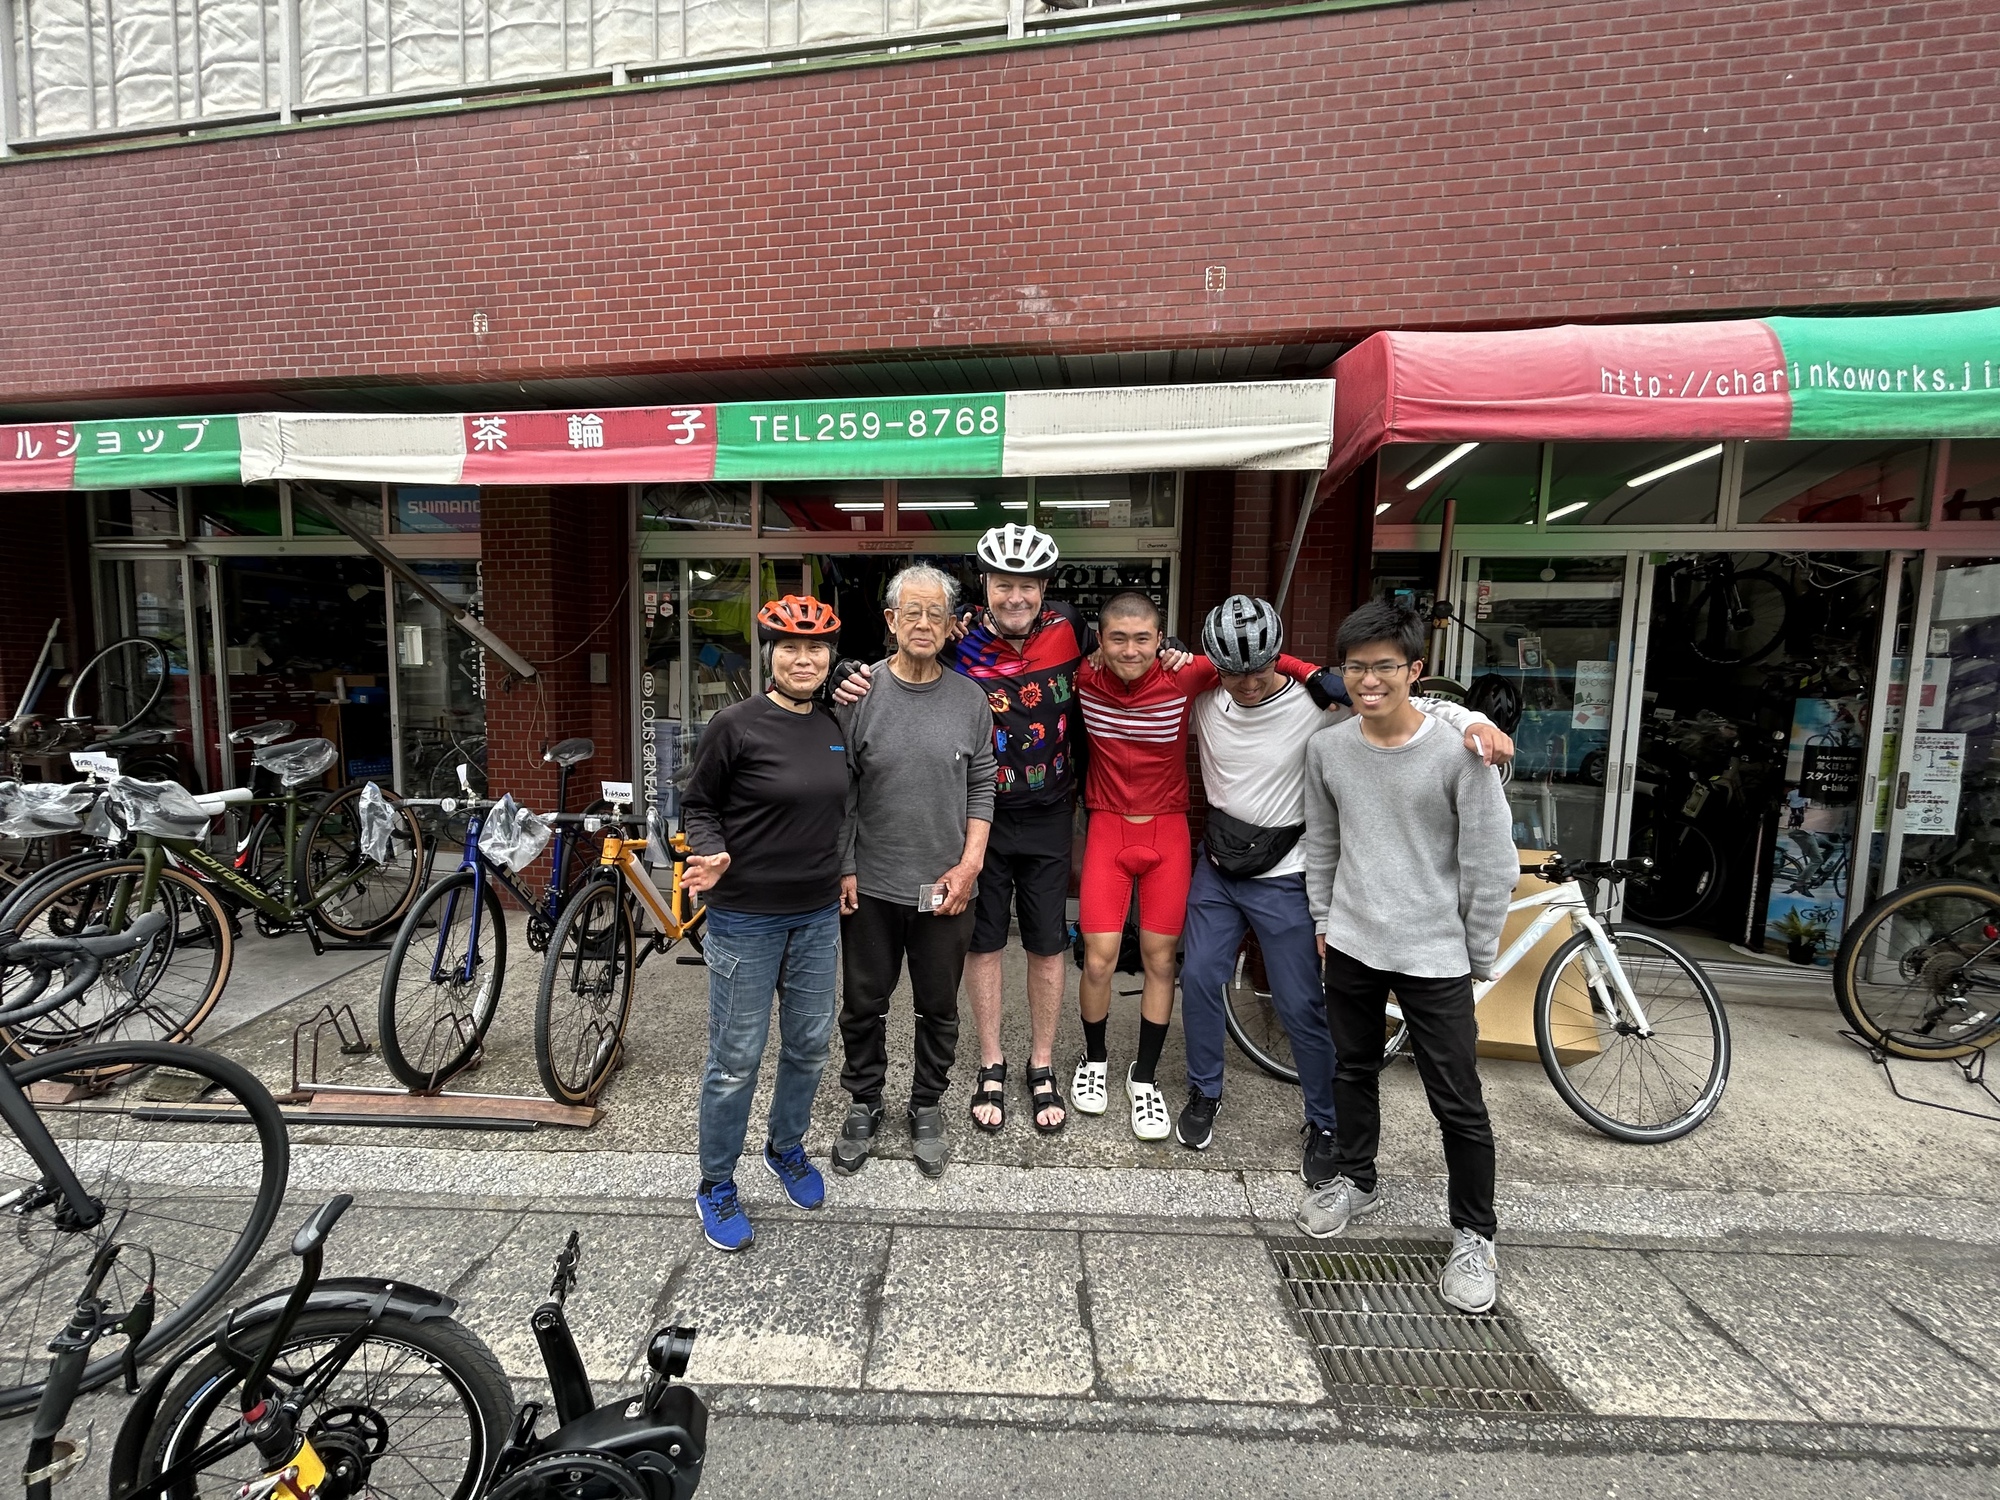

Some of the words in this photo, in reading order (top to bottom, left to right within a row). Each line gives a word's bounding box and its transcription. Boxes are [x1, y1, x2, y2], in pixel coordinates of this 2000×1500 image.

[1600, 359, 2000, 398] http://charinkoworks.ji
[16, 418, 210, 459] ルショップ
[471, 409, 707, 451] 茶輪子
[749, 405, 999, 442] TEL259-8768
[641, 701, 656, 741] LOUIS
[1821, 783, 1849, 792] e-bike
[189, 848, 267, 900] corratec
